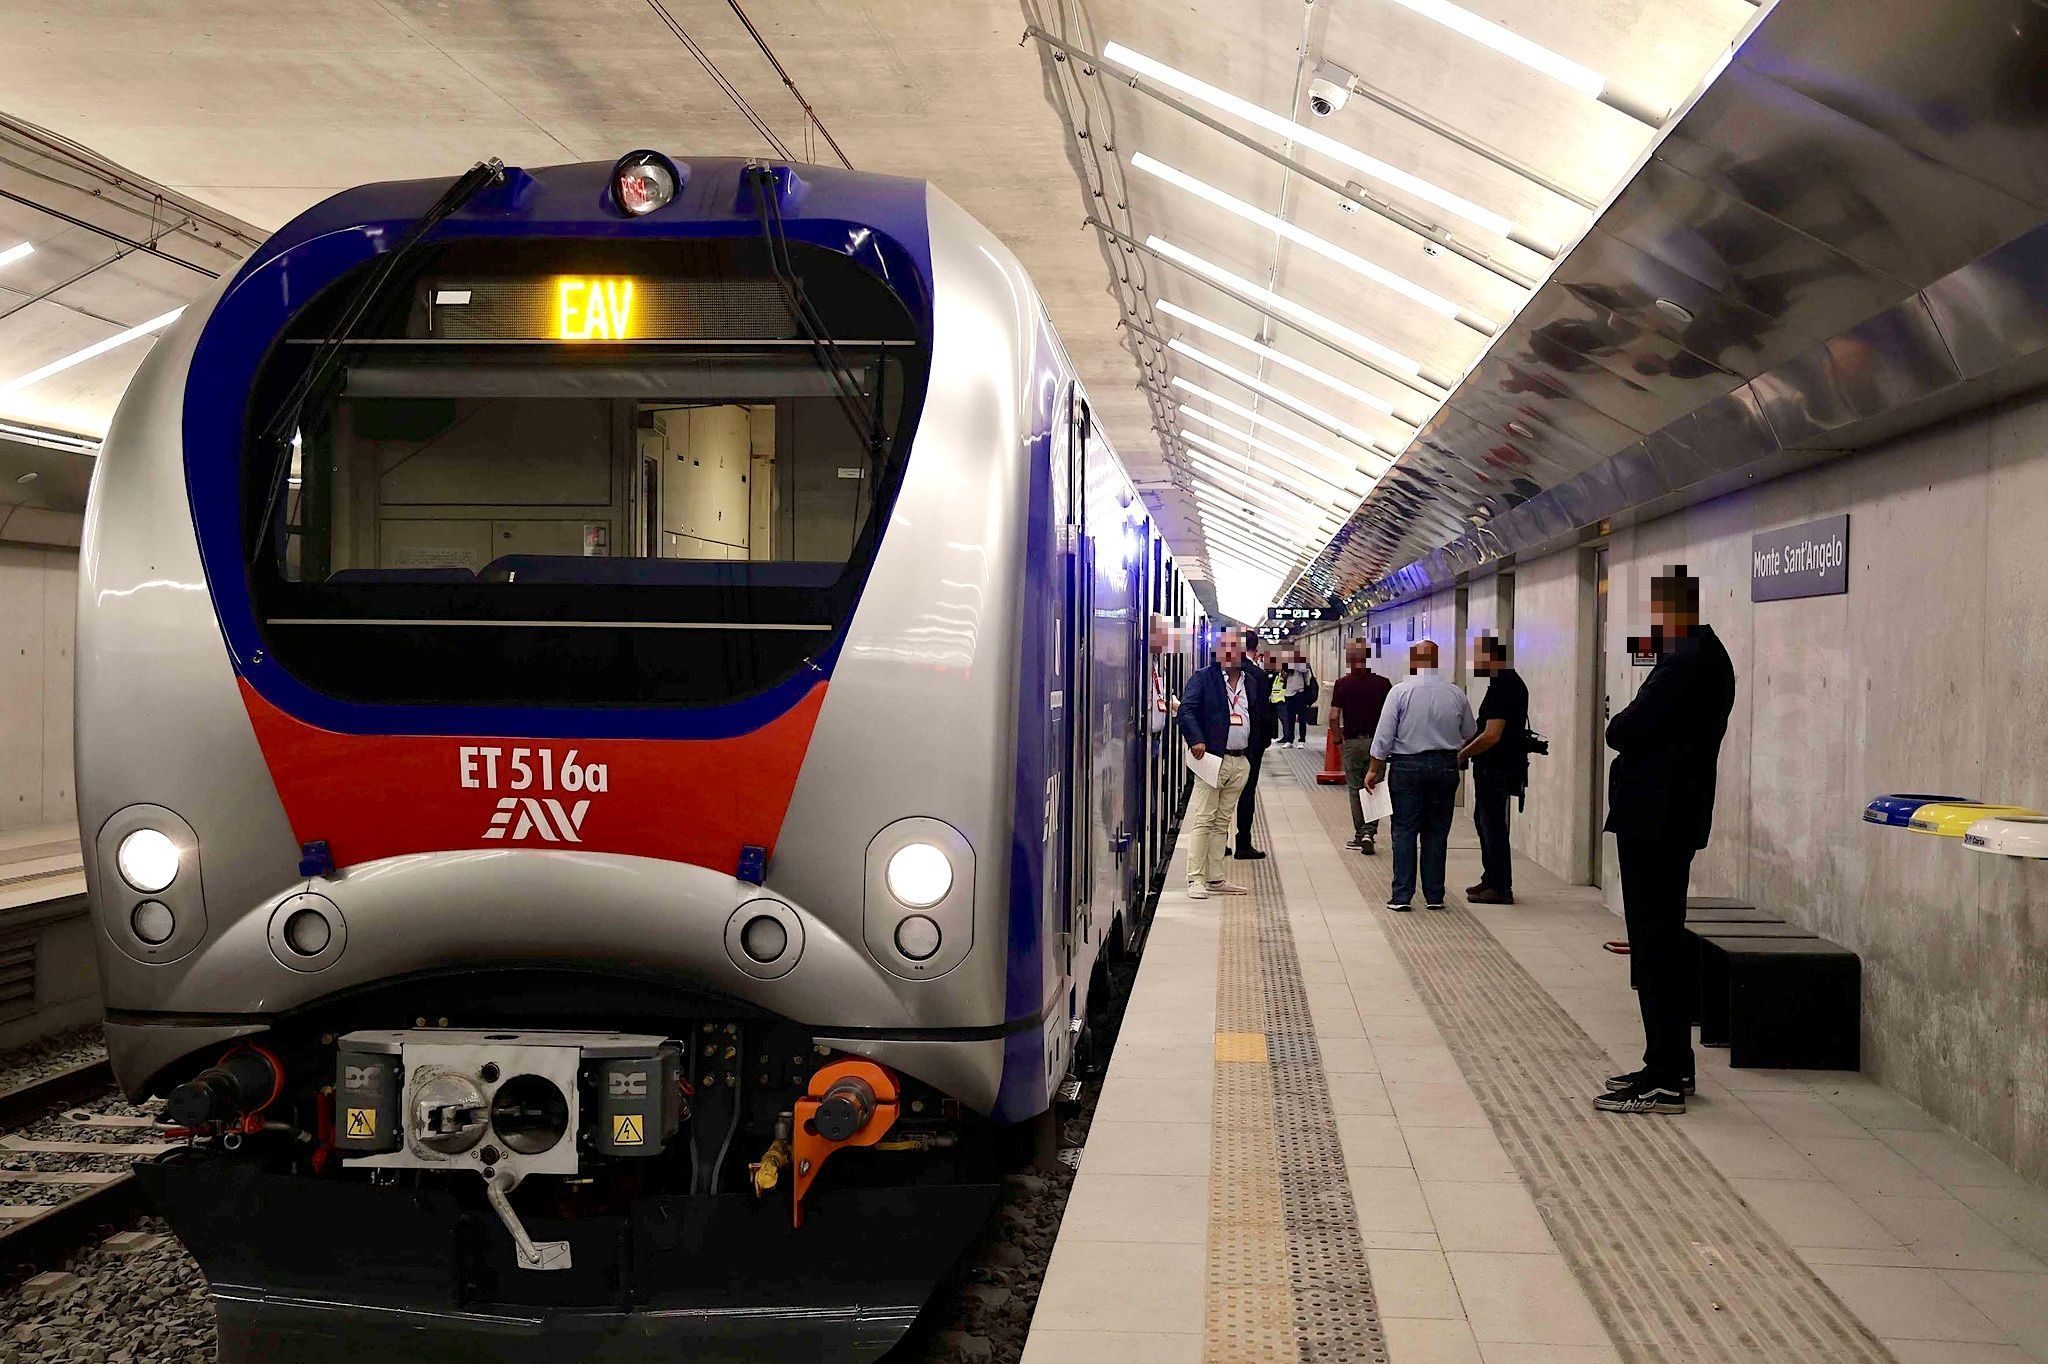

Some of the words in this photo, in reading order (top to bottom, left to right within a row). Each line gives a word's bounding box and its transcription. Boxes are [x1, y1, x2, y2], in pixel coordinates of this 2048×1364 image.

[559, 280, 634, 340] EAV
[1753, 548, 1780, 578] Monte
[1783, 534, 1843, 577] Sant'Angelo
[459, 746, 502, 789] ET
[510, 747, 608, 792] 516a
[481, 797, 593, 843] EAV
